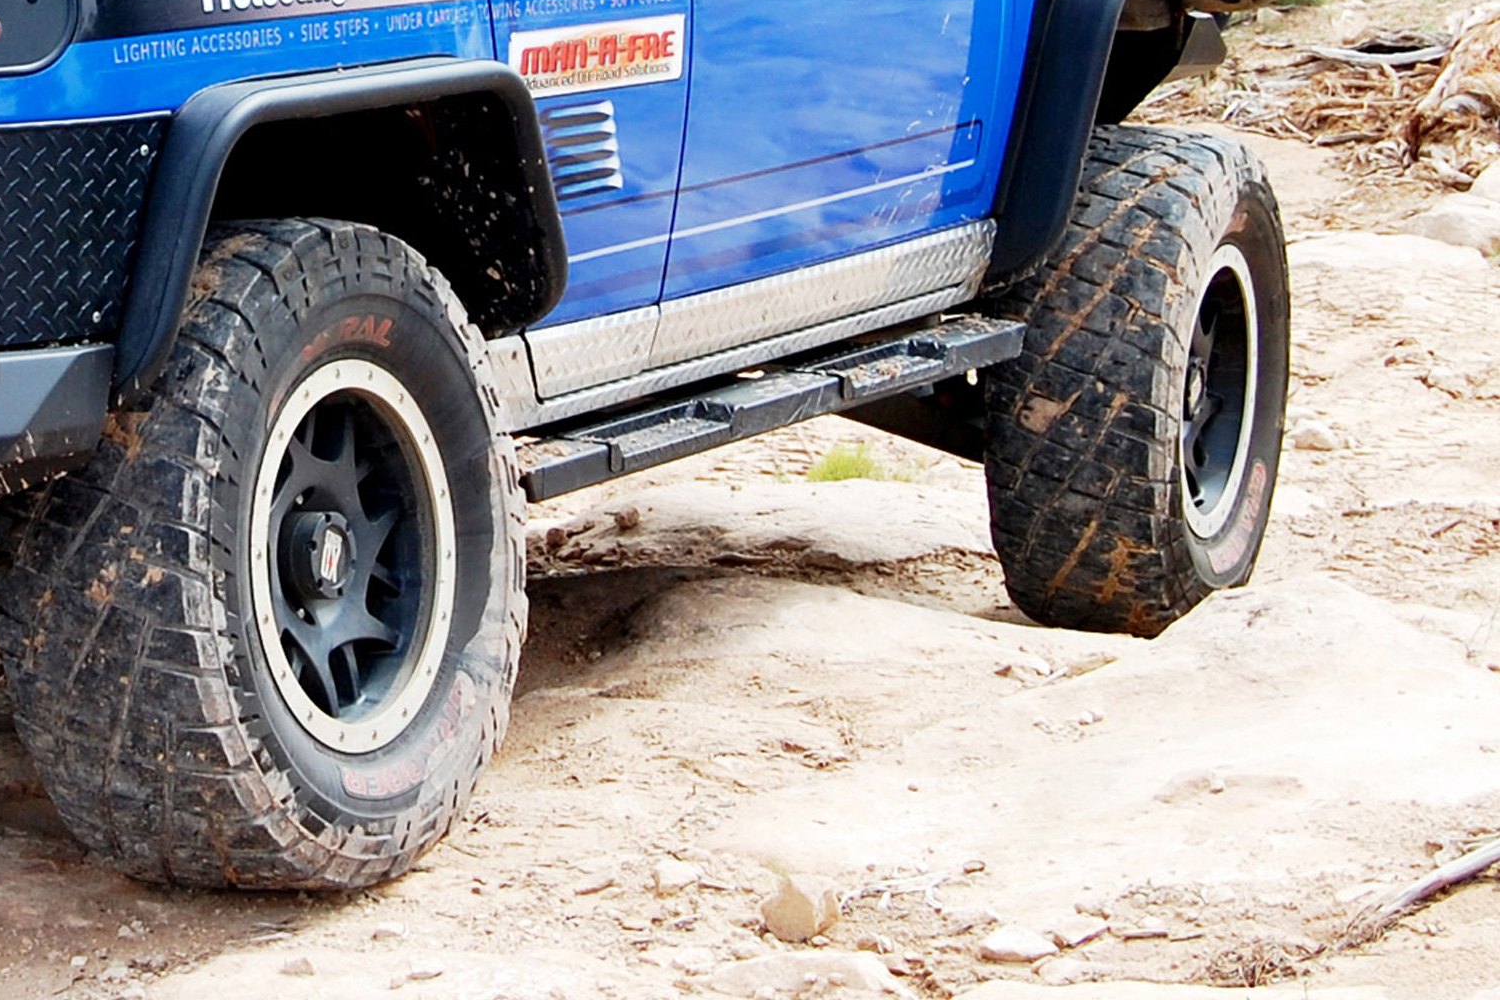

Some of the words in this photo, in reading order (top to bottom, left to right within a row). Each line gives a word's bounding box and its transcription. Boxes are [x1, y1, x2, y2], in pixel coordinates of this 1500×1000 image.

[114, 39, 187, 64] LIGHTING
[191, 26, 283, 55] ACCESSORIES
[301, 21, 329, 43] SIDE
[334, 17, 369, 39] STEPS
[386, 8, 424, 32] UNDER
